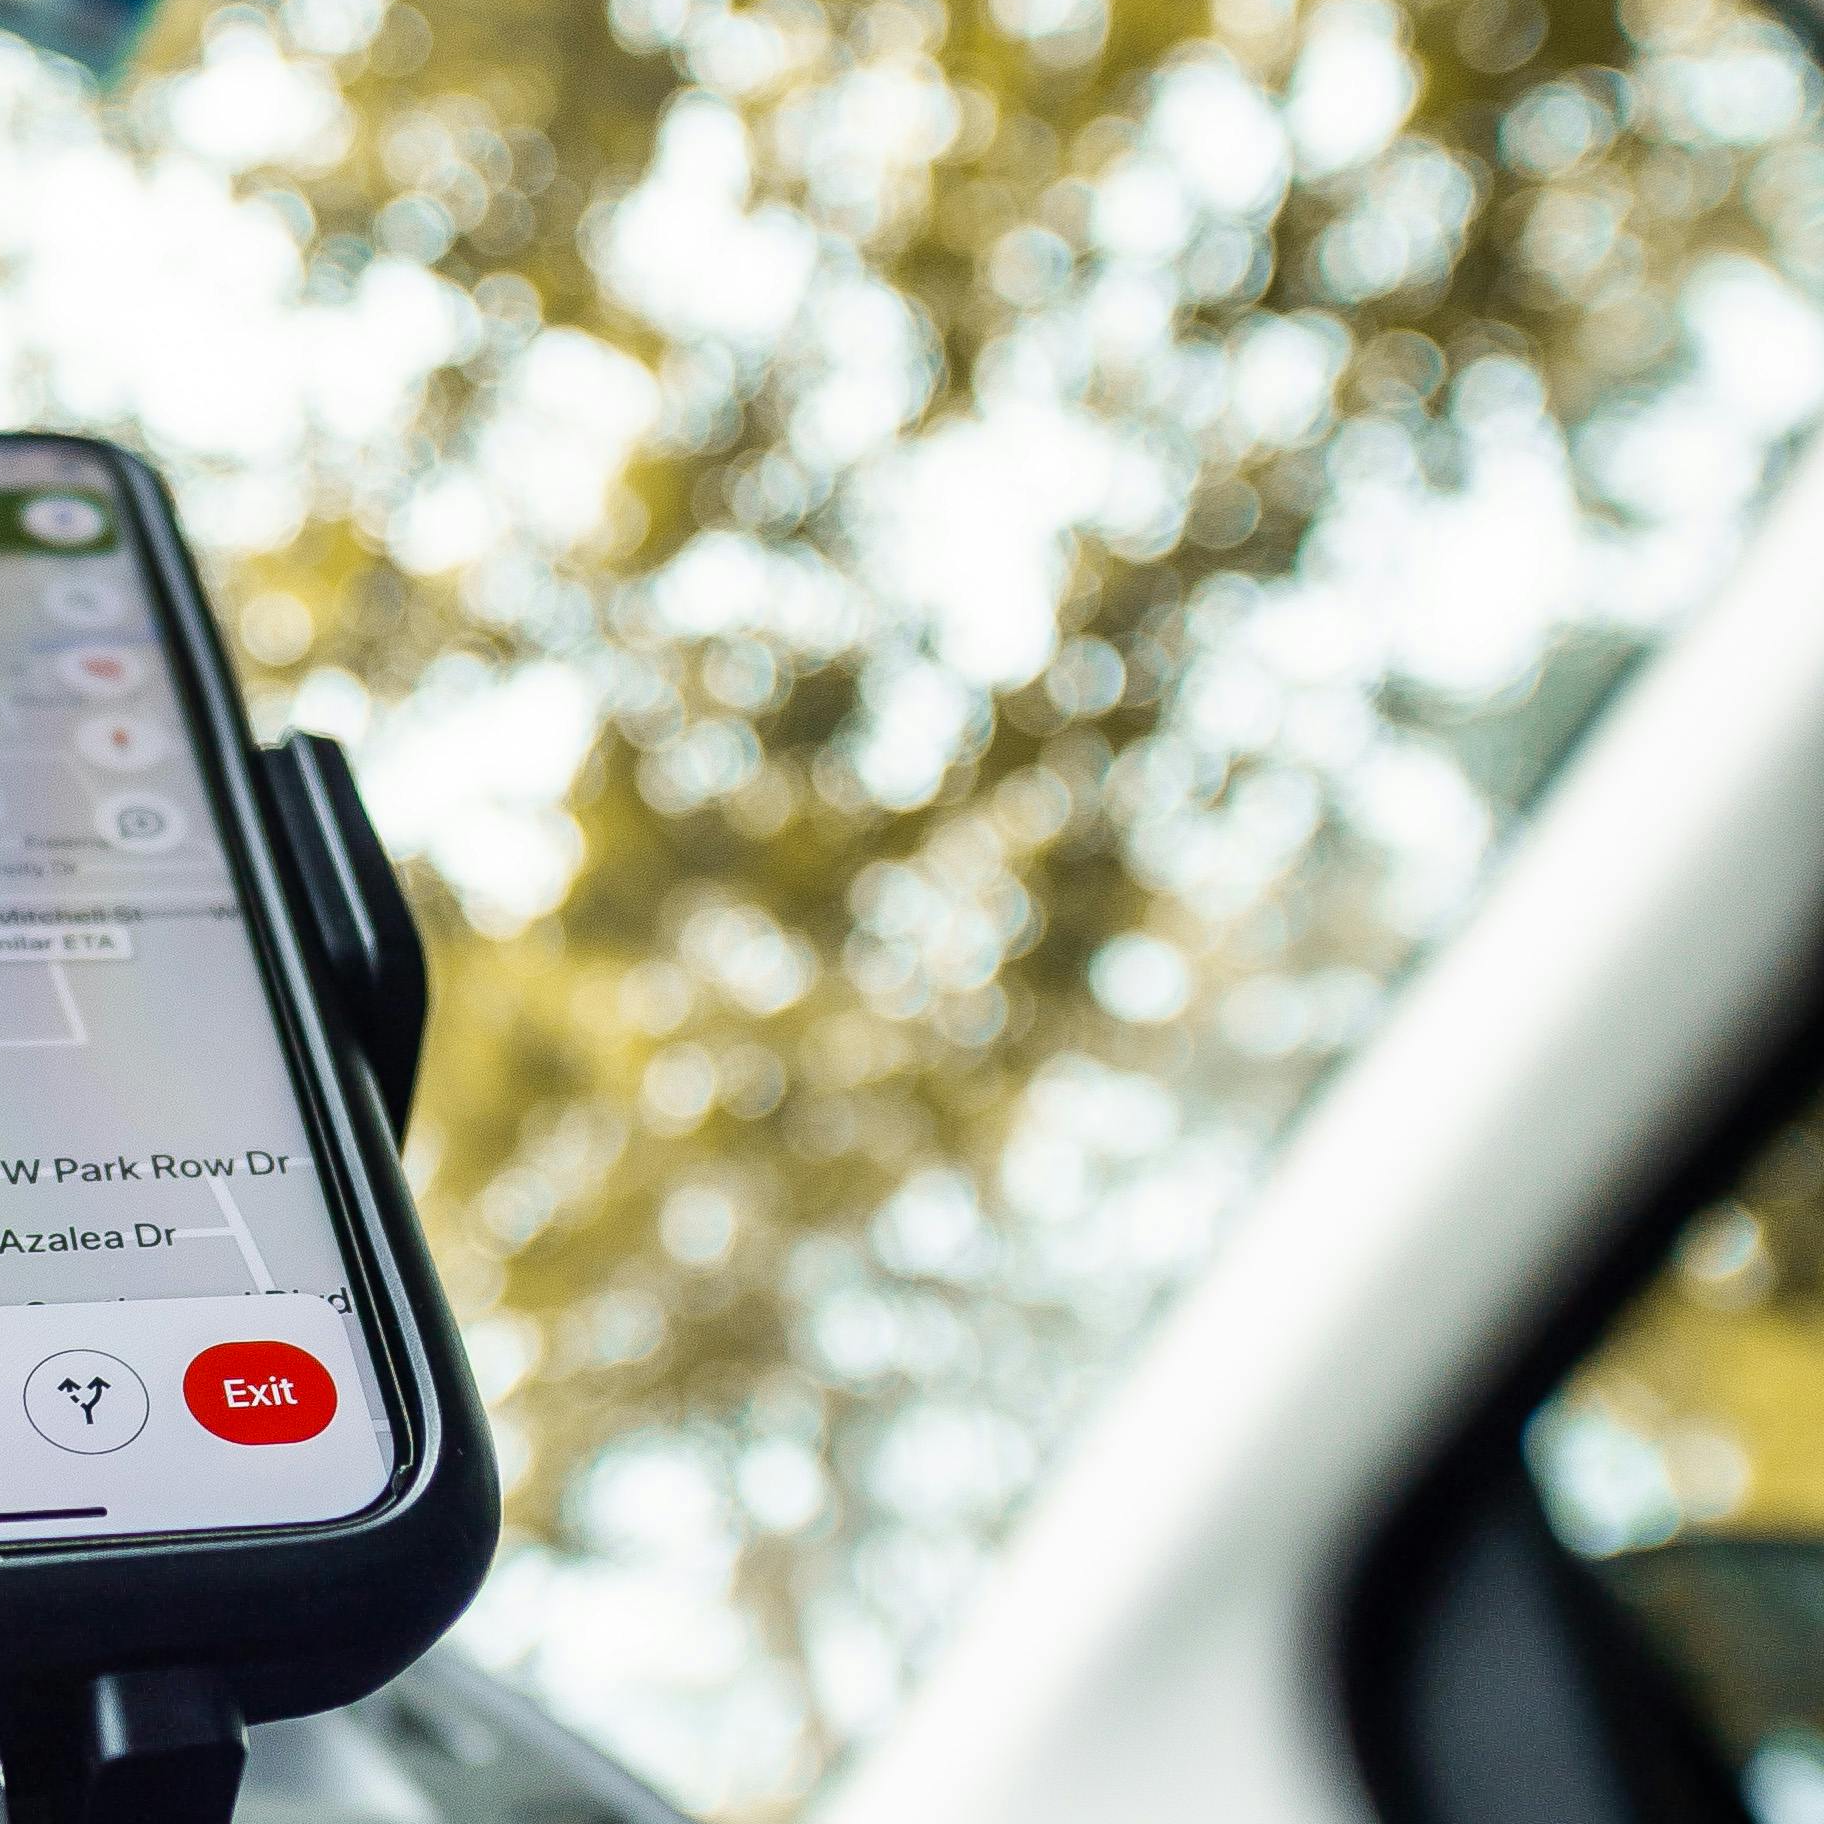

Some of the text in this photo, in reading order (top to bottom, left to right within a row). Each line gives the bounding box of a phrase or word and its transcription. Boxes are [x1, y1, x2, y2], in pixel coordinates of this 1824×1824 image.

[63, 934, 116, 950] ETA
[0, 1150, 291, 1185] W Park Row Dr
[135, 1223, 178, 1249] Dr
[222, 1375, 299, 1410] Exit
